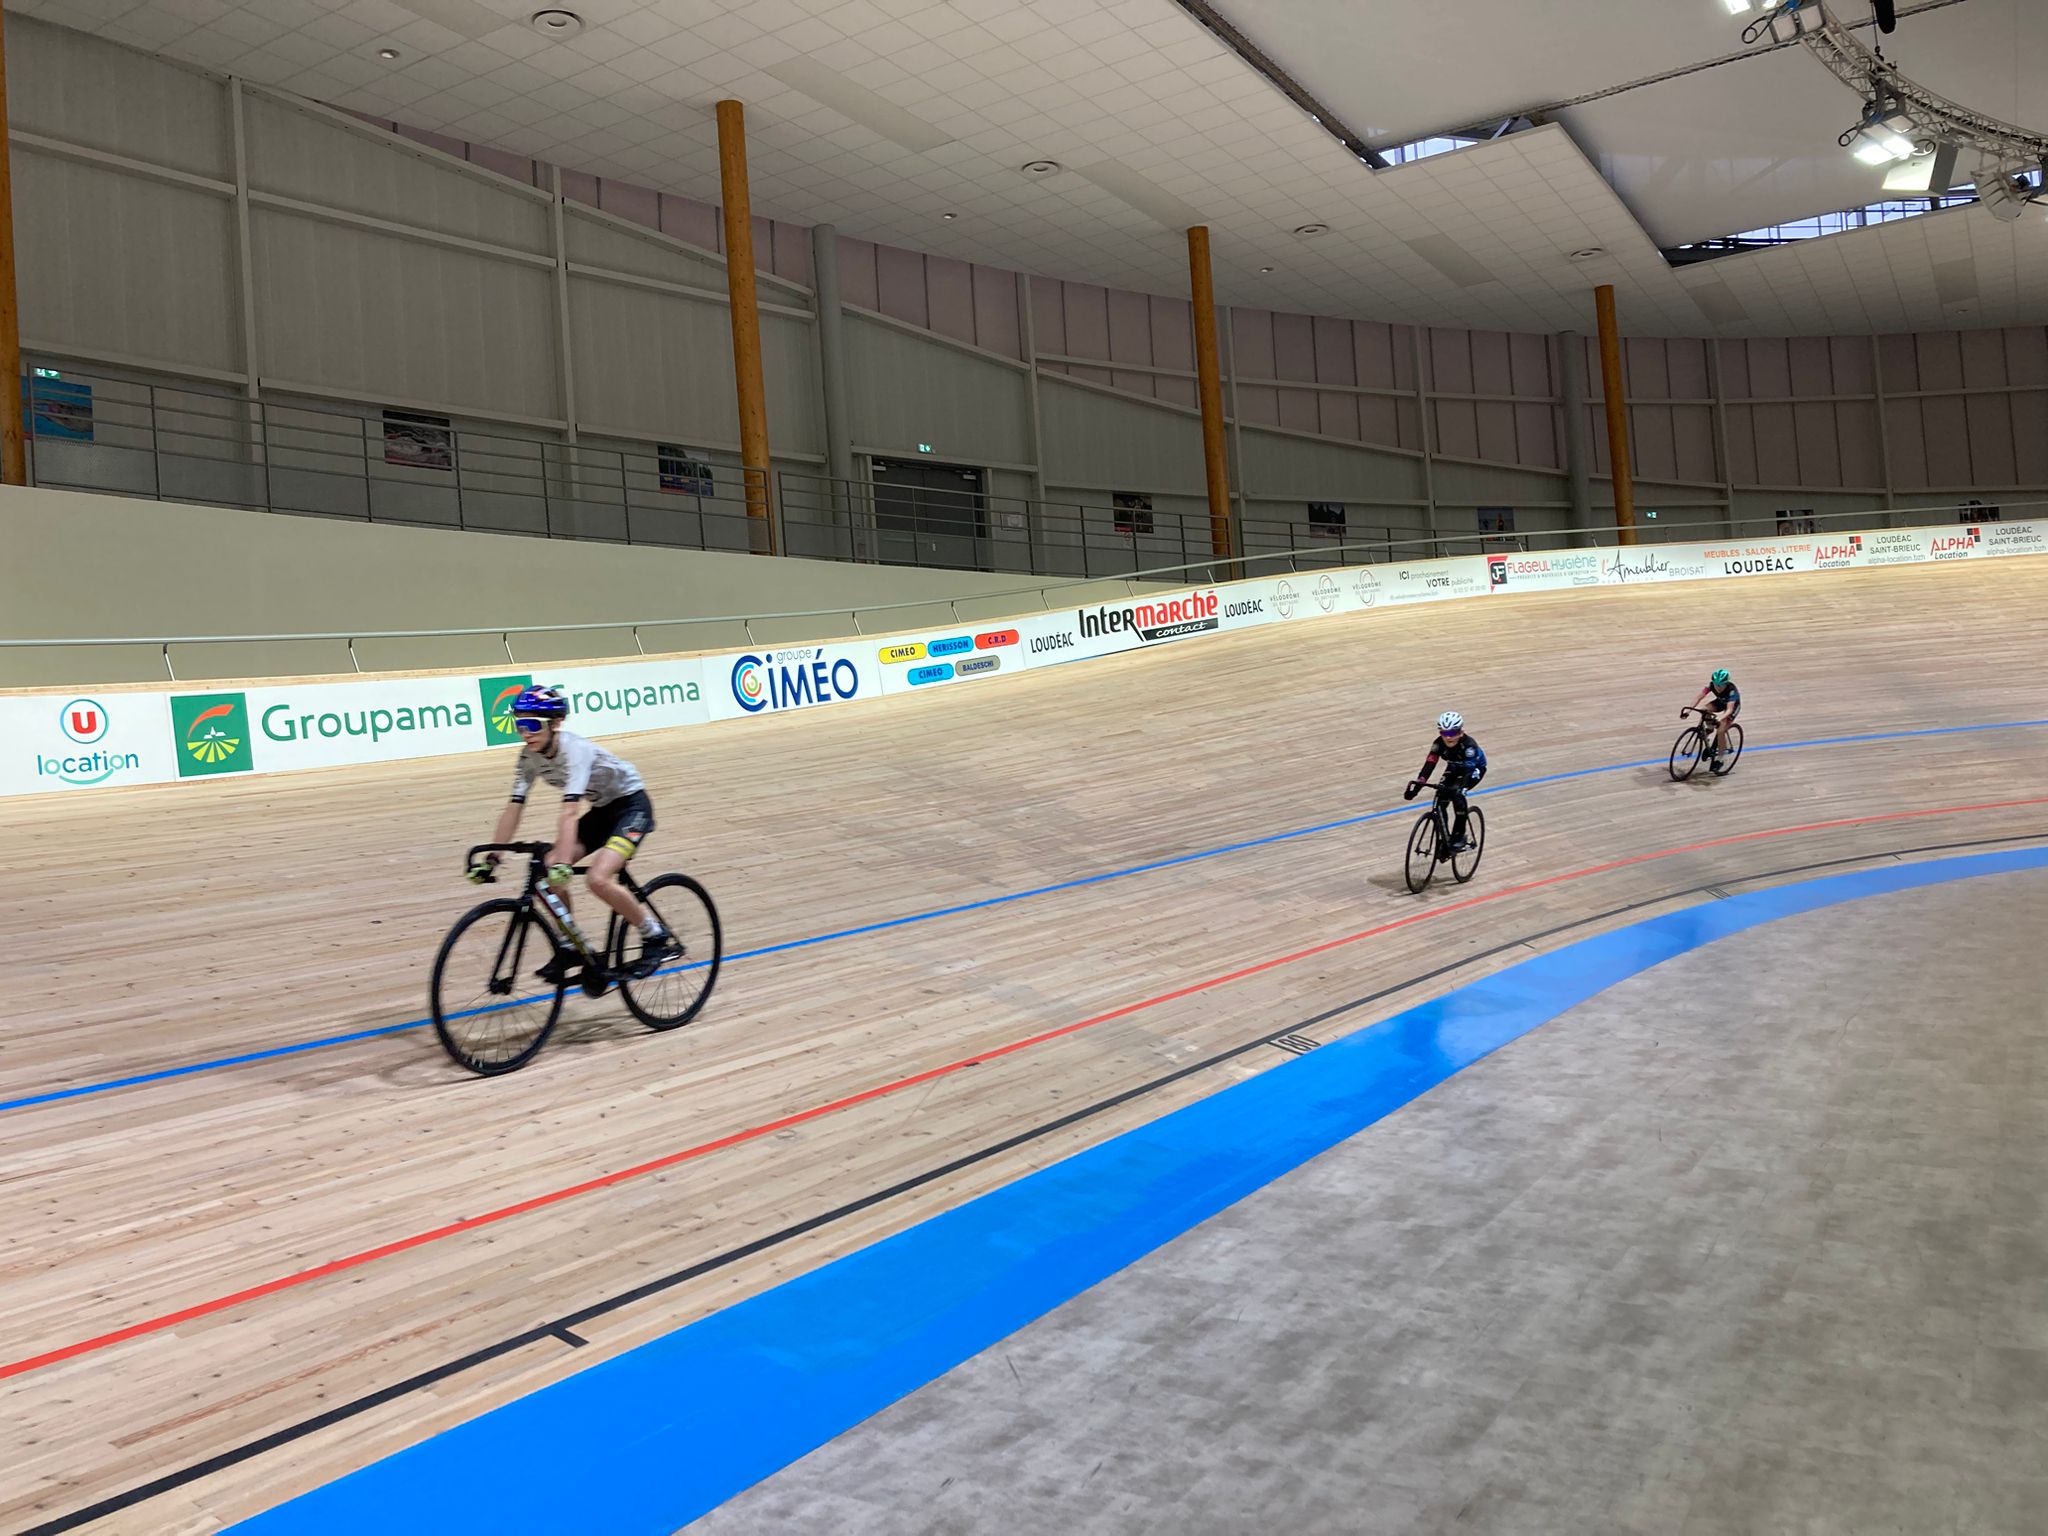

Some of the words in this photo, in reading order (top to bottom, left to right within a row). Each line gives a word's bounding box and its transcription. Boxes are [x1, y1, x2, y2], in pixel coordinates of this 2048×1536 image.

[1930, 537, 1974, 556] ALPHA
[1989, 535, 2042, 546] SAINT-BRIEUC
[1704, 549, 1740, 558] MEUBLES
[1745, 546, 1776, 556] SALONS
[1782, 544, 1811, 554] LITERIE
[1815, 545, 1857, 564] ALPHA
[1870, 544, 1921, 554] SAINT-BRIEUC
[1935, 551, 1968, 560] Location
[1724, 555, 1794, 574] LOUDÉAC
[1819, 560, 1850, 568] Location
[1399, 571, 1410, 580] ICI
[1669, 566, 1704, 577] BROISAT
[1426, 577, 1450, 588] VOTRE
[1224, 598, 1264, 618] LOUDÉAC
[1156, 621, 1208, 638] contact
[932, 640, 969, 653] HERISSON
[1030, 632, 1074, 653] LOUDÉAC
[777, 648, 812, 664] groupe
[890, 646, 916, 658] CIMEO
[962, 660, 994, 672] BALDESCHI
[918, 668, 943, 679] CIMEO
[72, 711, 97, 734] U
[261, 703, 473, 743] Groupama
[37, 750, 140, 775] location
